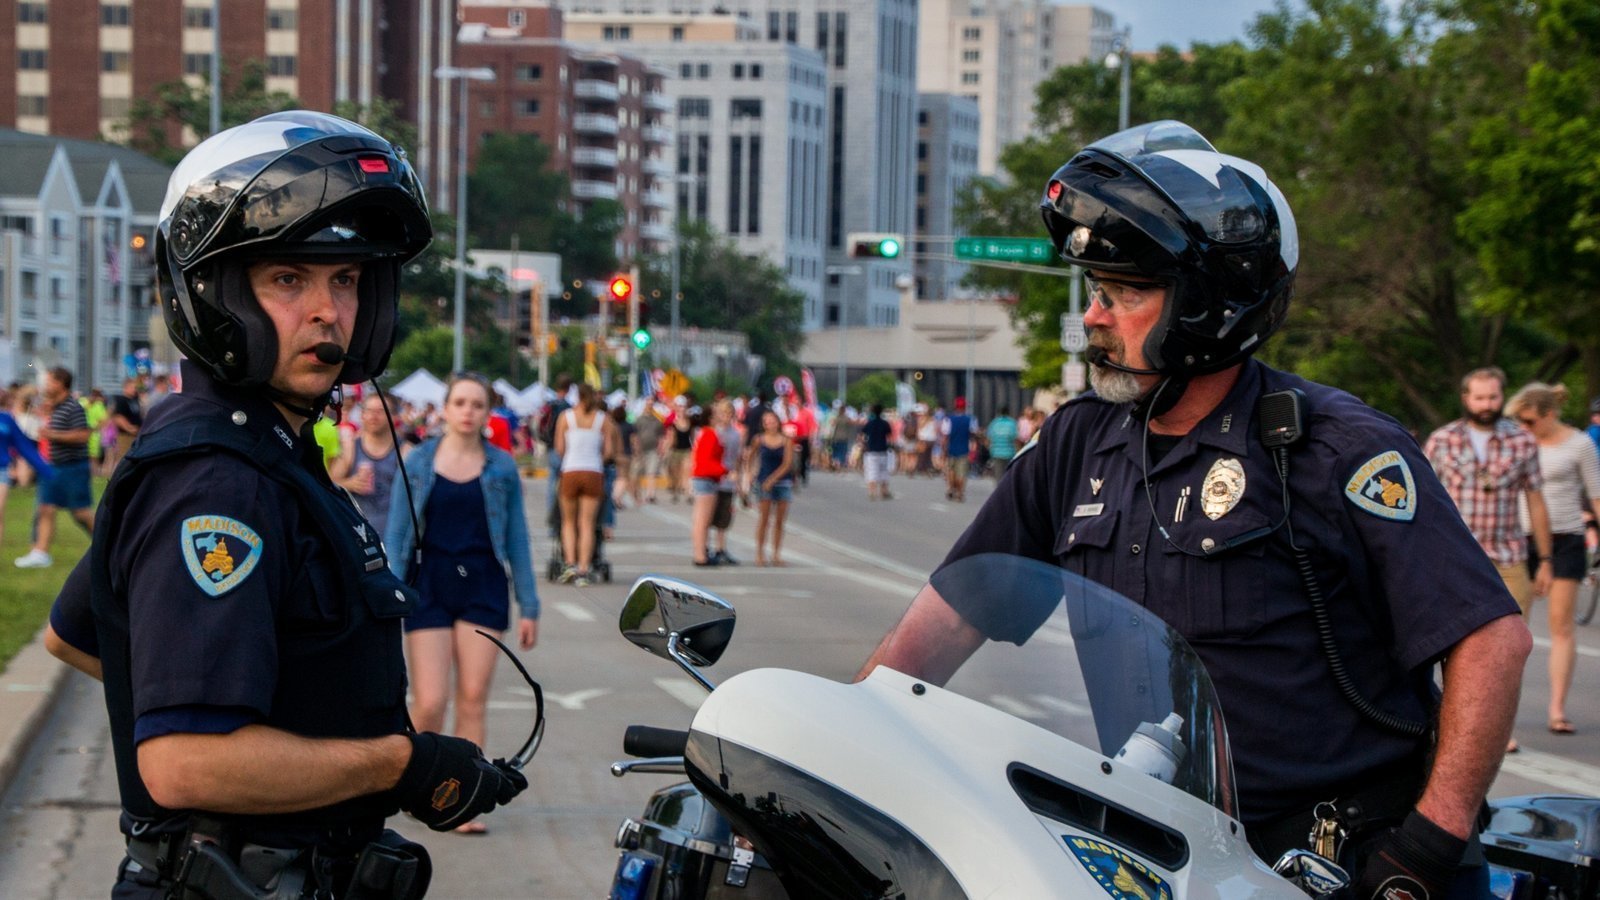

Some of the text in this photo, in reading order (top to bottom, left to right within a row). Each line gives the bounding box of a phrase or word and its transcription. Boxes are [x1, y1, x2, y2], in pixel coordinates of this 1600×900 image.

[1347, 452, 1400, 494] MADISON
[187, 516, 260, 548] MADISON
[1071, 838, 1161, 884] MADISON
